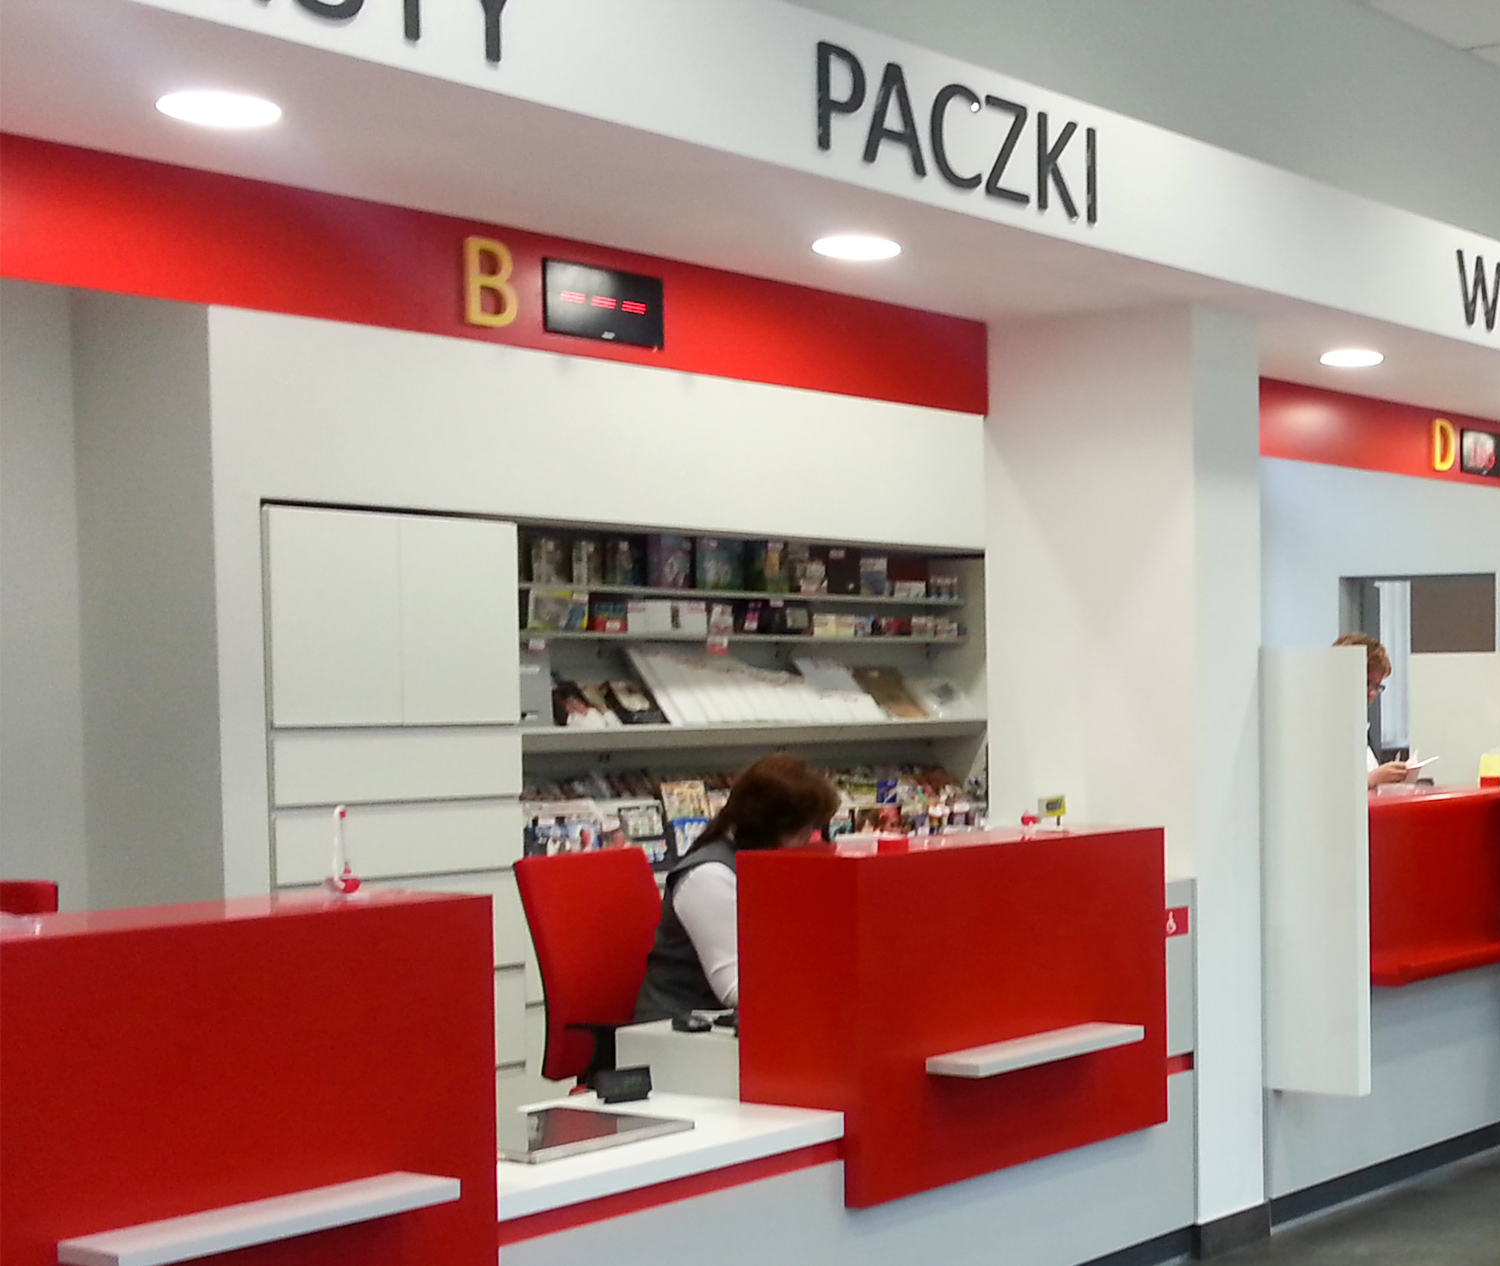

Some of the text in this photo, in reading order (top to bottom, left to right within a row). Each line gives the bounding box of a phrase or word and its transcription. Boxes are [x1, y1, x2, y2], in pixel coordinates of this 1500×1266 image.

[817, 41, 1097, 224] PACZKI
[464, 234, 518, 327] B
[1432, 418, 1456, 471] D
